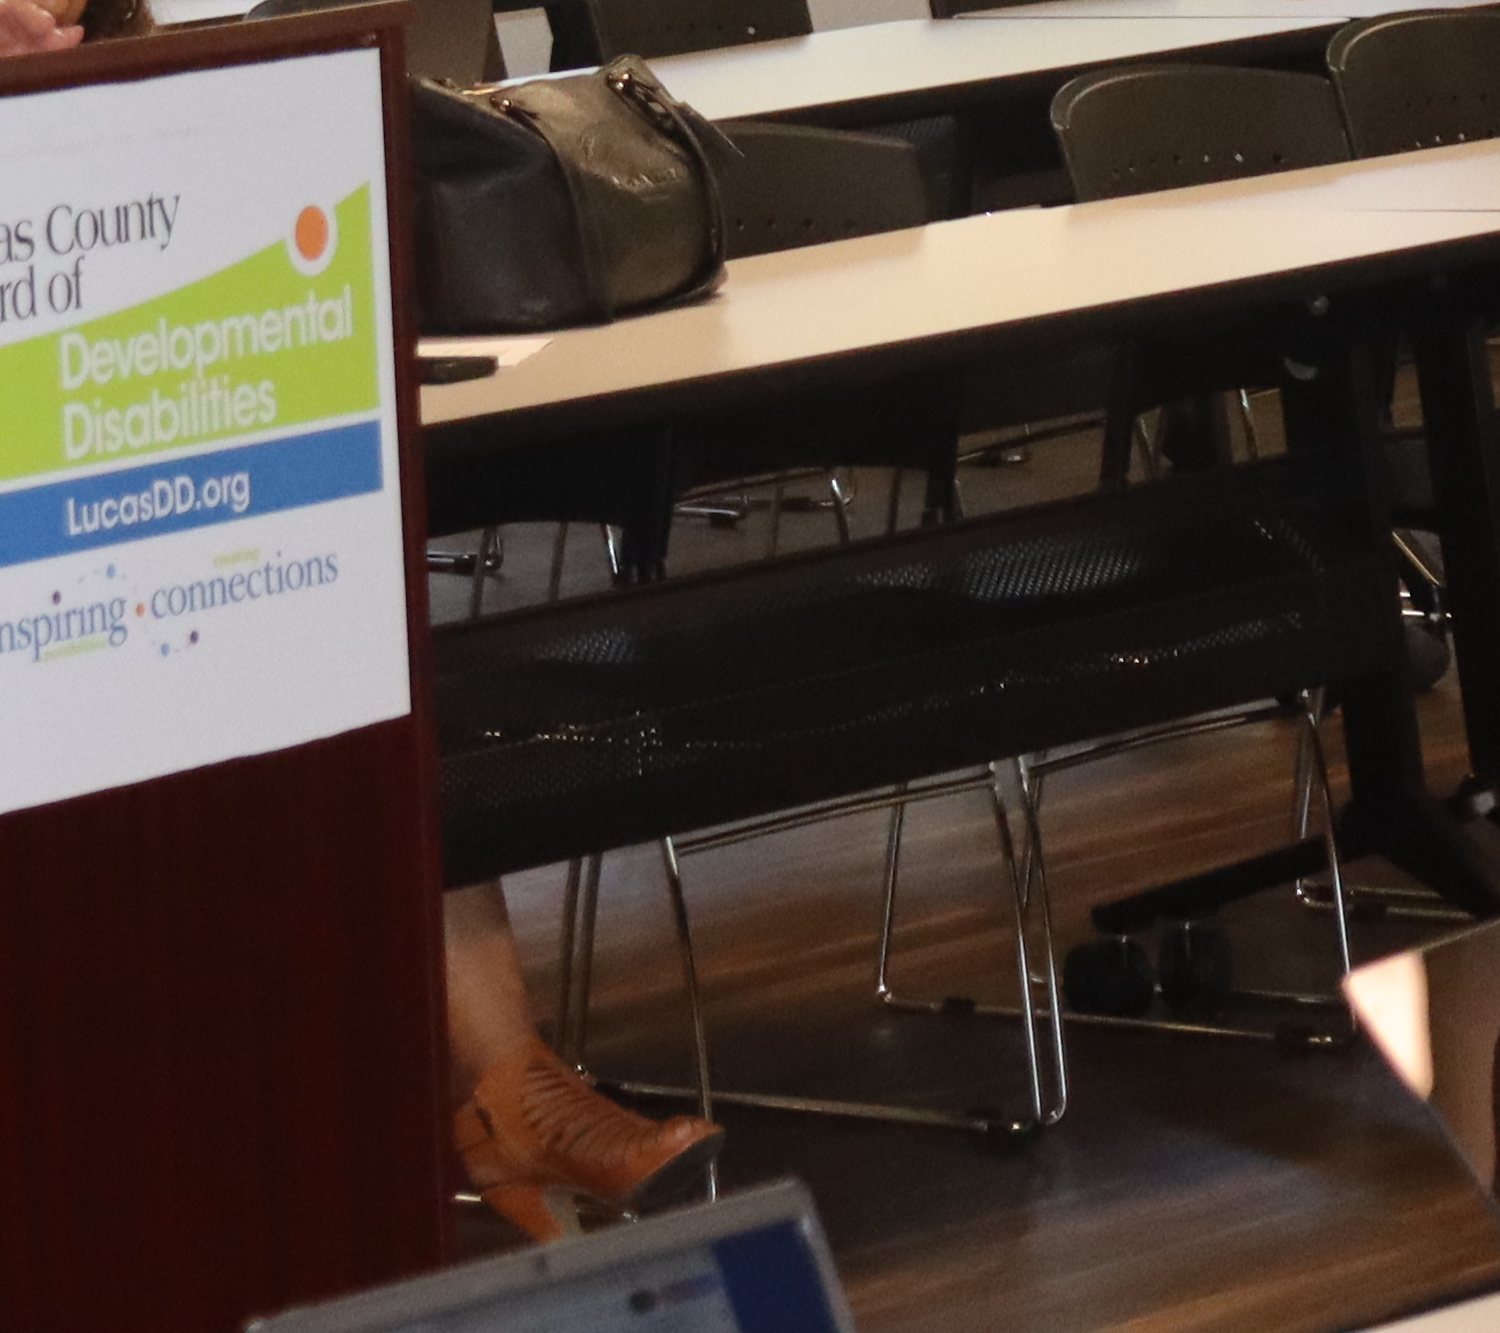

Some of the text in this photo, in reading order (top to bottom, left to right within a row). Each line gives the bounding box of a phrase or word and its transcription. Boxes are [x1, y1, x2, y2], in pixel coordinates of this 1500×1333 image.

[46, 192, 180, 255] County
[48, 255, 85, 313] of
[60, 284, 353, 390] Developmental
[63, 375, 277, 461] Disabilities
[66, 471, 250, 536] LucasDD.org
[150, 550, 339, 619] connections
